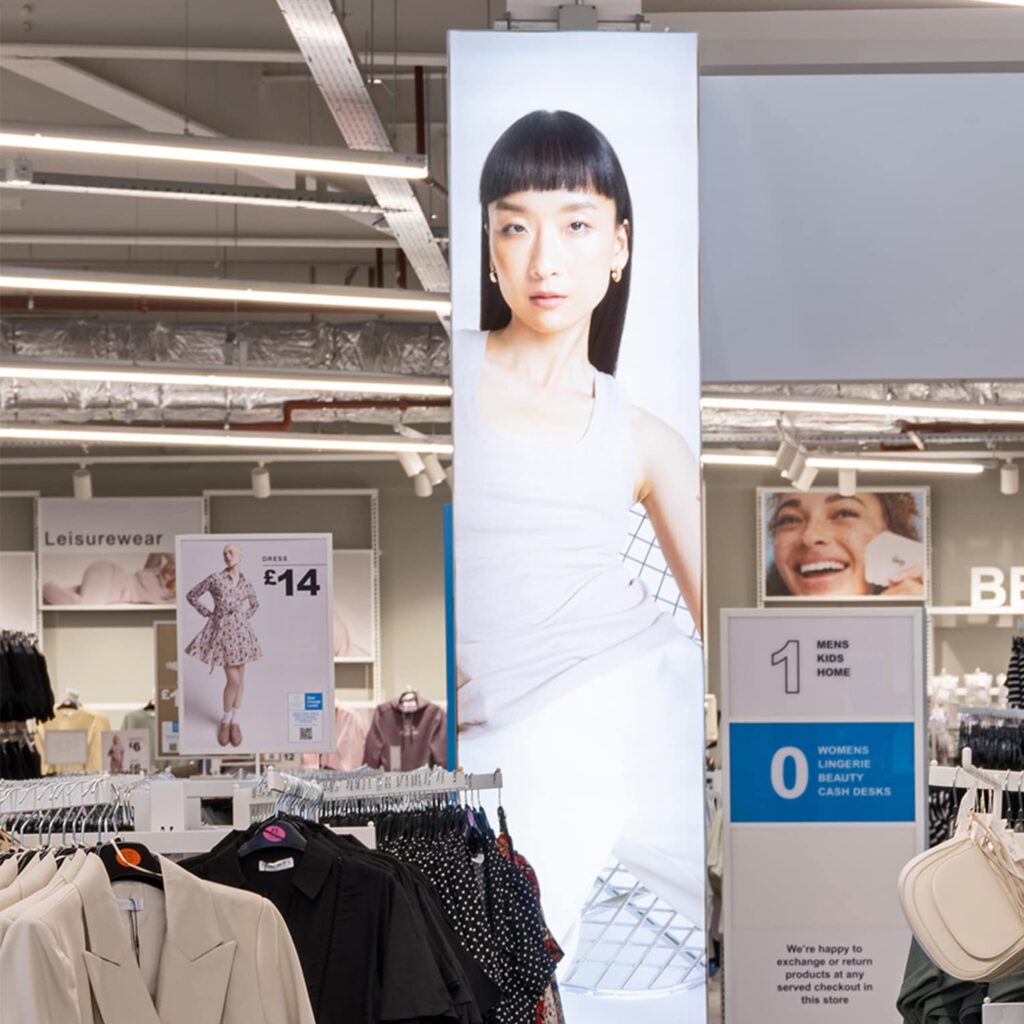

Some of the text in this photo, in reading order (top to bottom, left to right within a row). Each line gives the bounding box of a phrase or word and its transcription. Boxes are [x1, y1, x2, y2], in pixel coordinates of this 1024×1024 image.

[44, 531, 163, 546] Leisurewear
[264, 568, 321, 596] £14
[816, 640, 849, 649] MENS
[816, 654, 844, 663] KIDS
[771, 640, 800, 694] 1
[817, 668, 851, 677] HOME
[818, 746, 870, 755] WOMENS
[818, 760, 871, 769] LINGERIE
[770, 746, 809, 799] 0
[818, 773, 864, 783] BEAUTY
[818, 787, 891, 796] CASH DESKS
[786, 944, 863, 955] We're happy to
[776, 958, 826, 968] exchange
[842, 958, 873, 966] return
[785, 971, 865, 980] products at any
[777, 983, 873, 992] served checkout in
[801, 996, 849, 1004] this store
